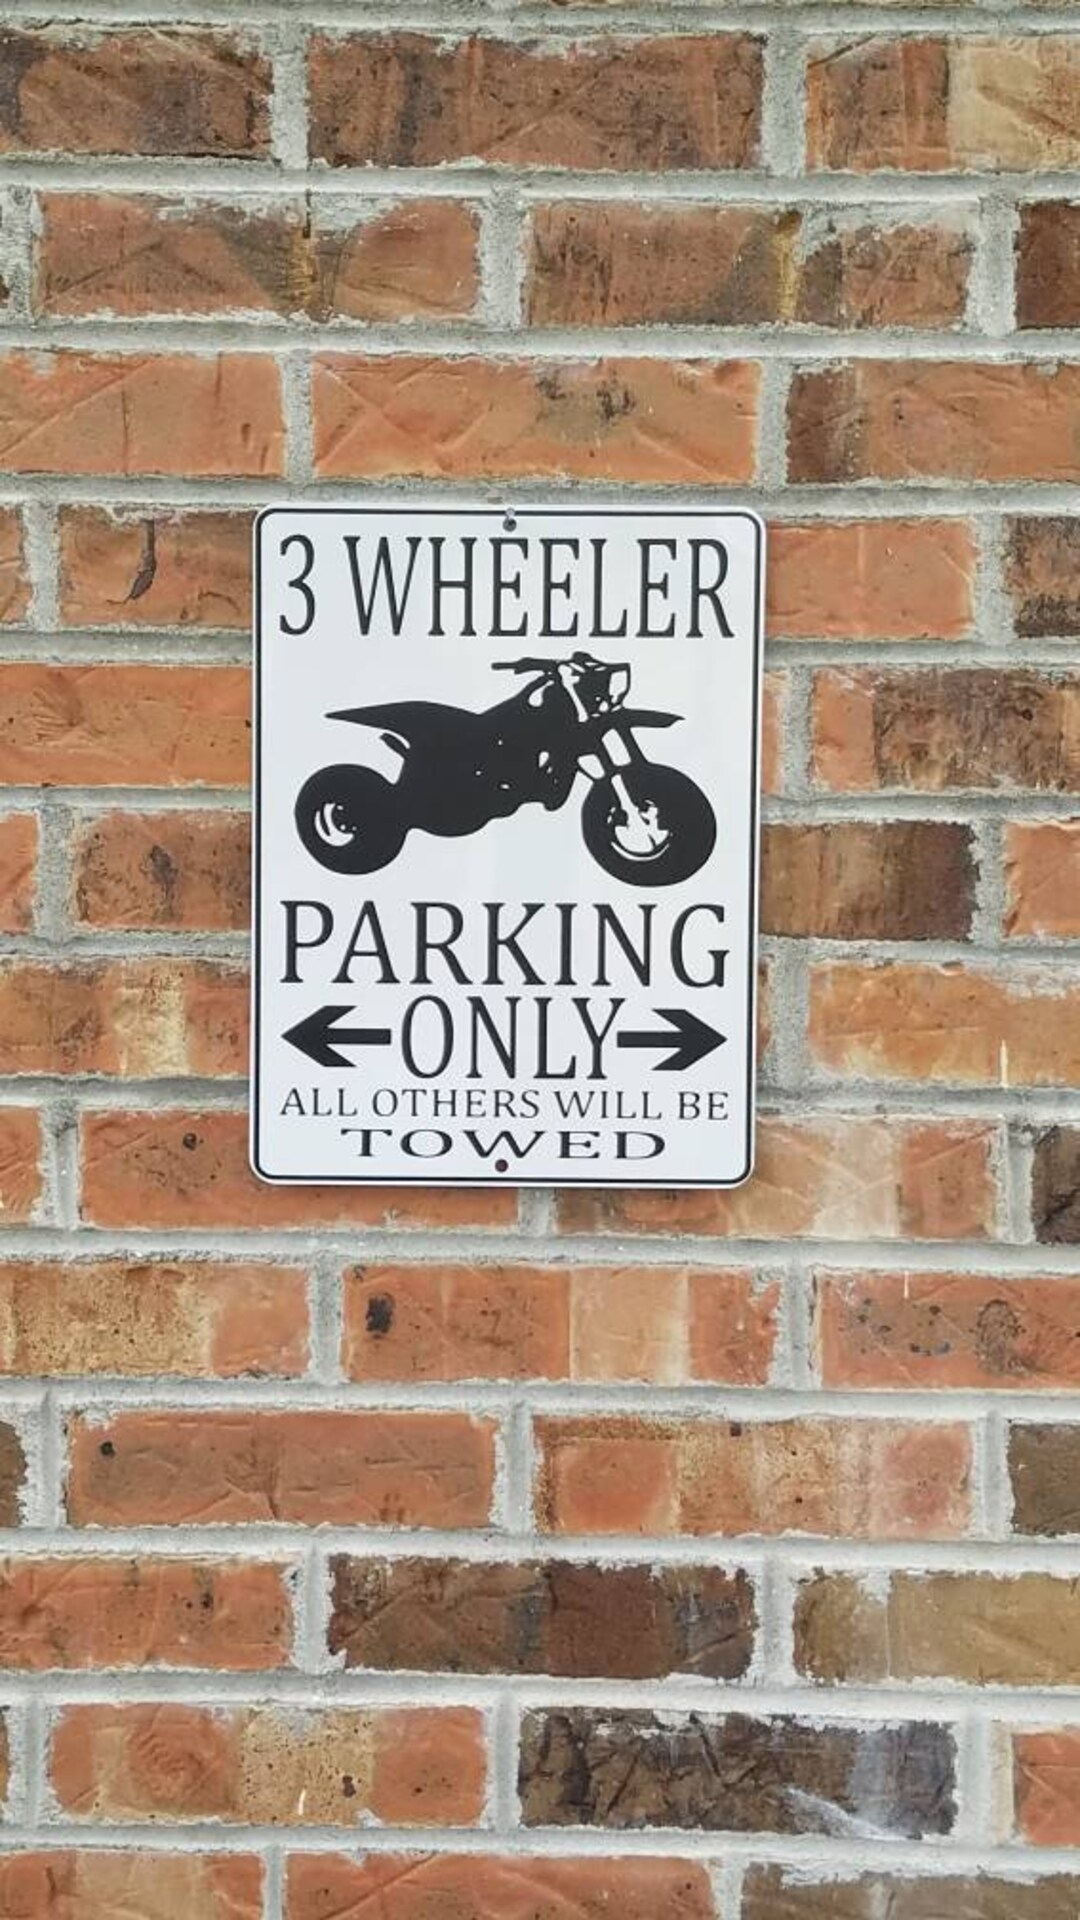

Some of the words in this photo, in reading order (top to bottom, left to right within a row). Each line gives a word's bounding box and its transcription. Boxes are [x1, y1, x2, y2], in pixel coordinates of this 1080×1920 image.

[279, 534, 316, 636] 3
[342, 534, 735, 638] WHEELER
[280, 900, 730, 988] PARKING
[401, 995, 626, 1080] ONLY
[280, 1088, 358, 1118] ALL
[371, 1088, 540, 1119] OTHERS
[554, 1090, 663, 1119] WILL
[678, 1091, 729, 1121] BE
[341, 1128, 666, 1160] TOWED
